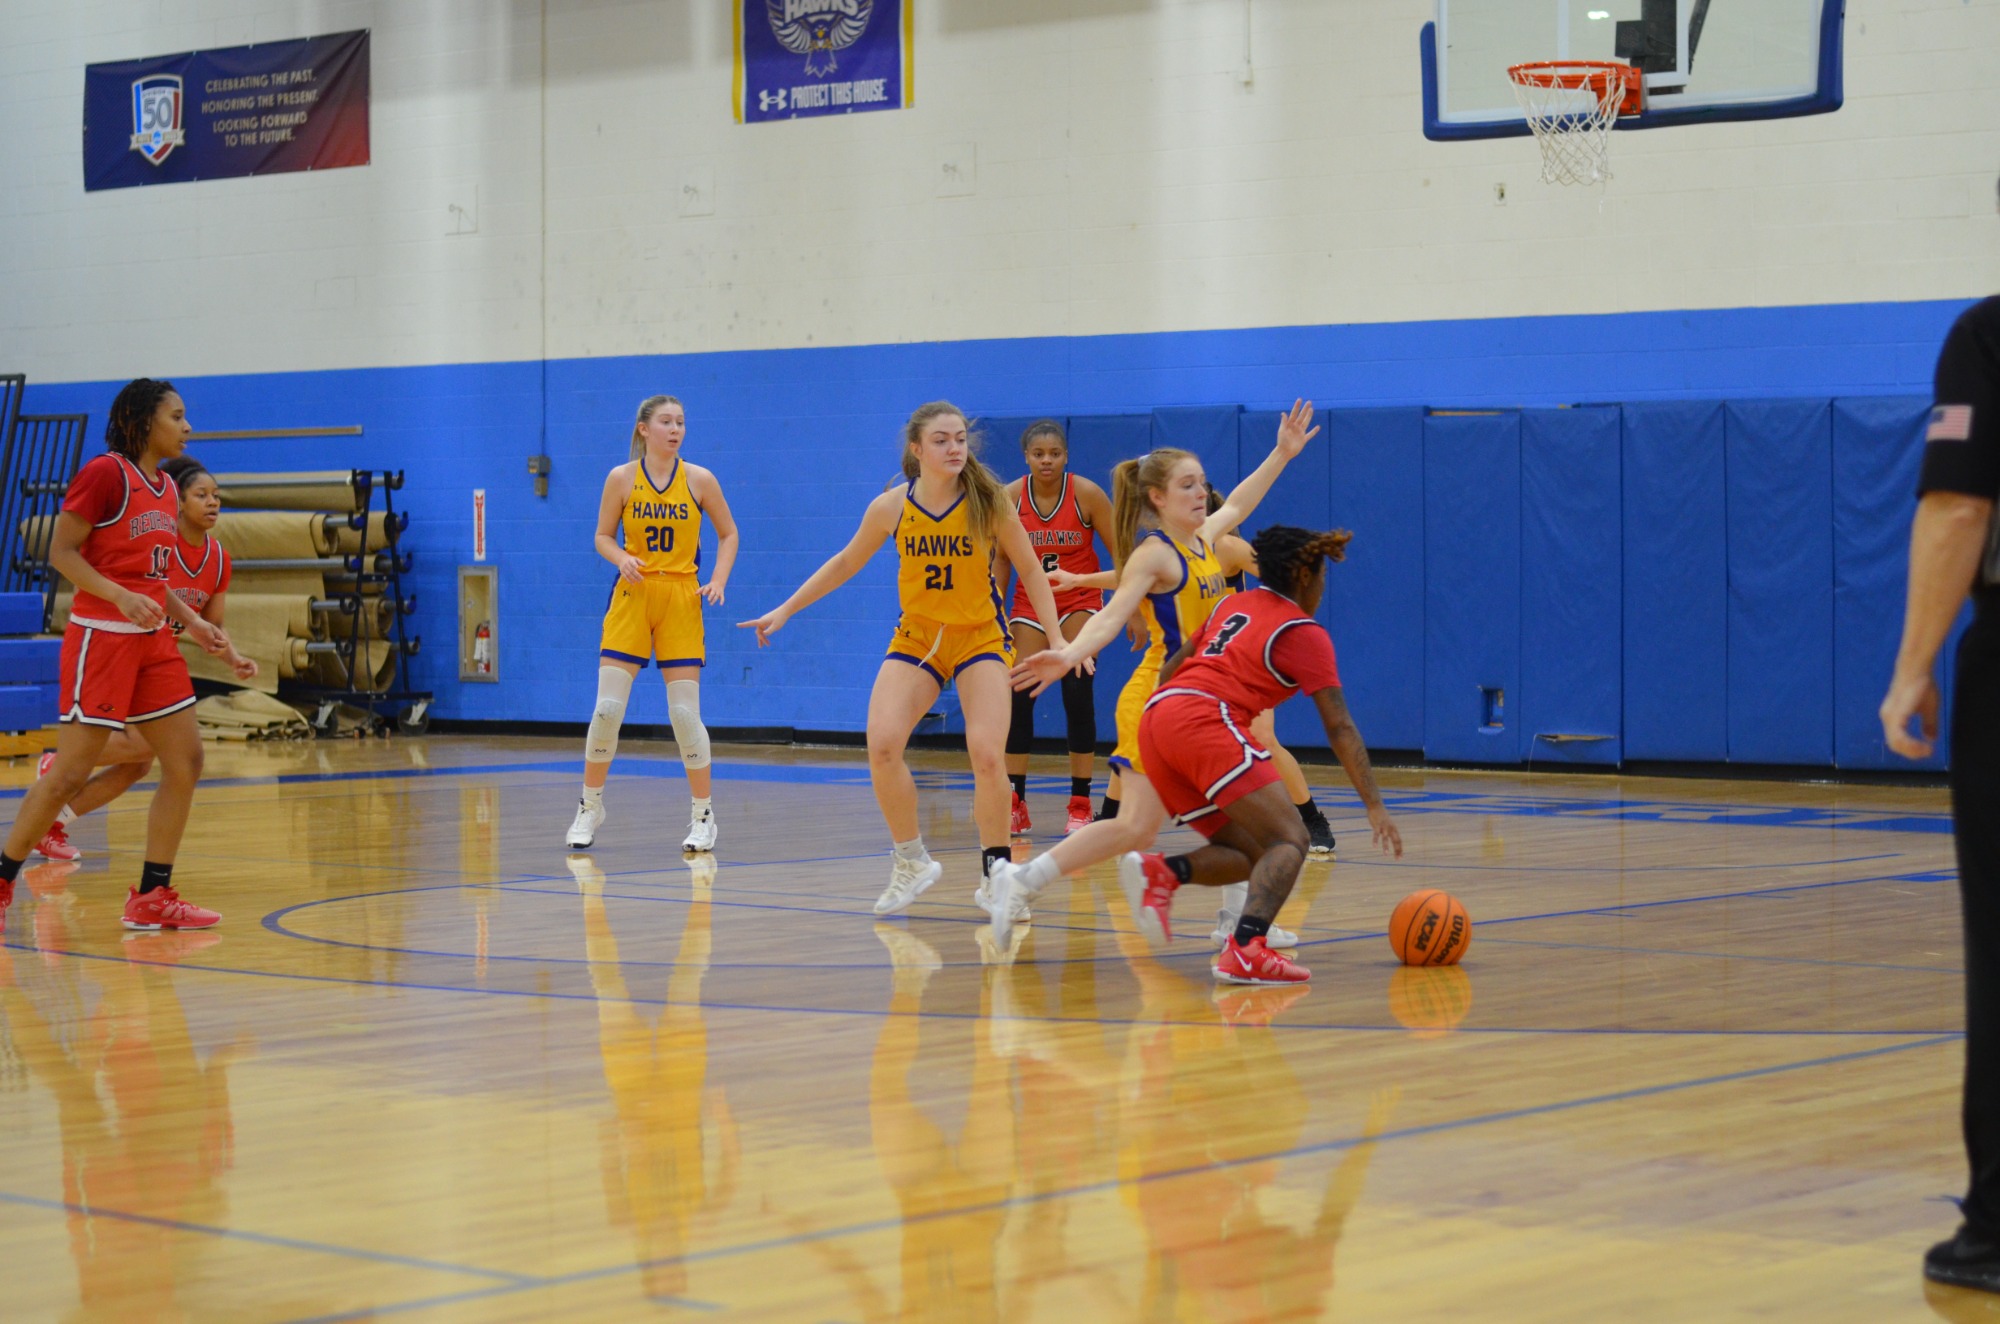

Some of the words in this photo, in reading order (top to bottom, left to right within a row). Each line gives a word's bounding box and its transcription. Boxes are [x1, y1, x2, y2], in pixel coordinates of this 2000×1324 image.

[205, 74, 269, 94] CELEBRATING
[271, 71, 288, 86] THE
[290, 68, 317, 84] PAST.
[201, 96, 255, 114] HONORING
[257, 93, 275, 108] THE
[277, 88, 319, 106] PRESENT.
[791, 83, 829, 109] PROTECT
[831, 81, 852, 105] THIS
[143, 97, 172, 129] 50
[212, 116, 259, 133] LOOKING
[261, 110, 308, 128] FORWARD
[225, 133, 238, 147] TO
[240, 131, 257, 146] THE
[259, 127, 296, 143] FUTURE.
[632, 501, 688, 520] HAWKS
[129, 510, 177, 541] REDHAW
[1028, 529, 1083, 547] DHAWKS
[645, 526, 674, 552] 20
[905, 535, 974, 557] HAWKS
[144, 544, 172, 581] 11
[924, 563, 954, 591] 21
[1202, 611, 1251, 657] 3
[1414, 909, 1440, 952] NCAA
